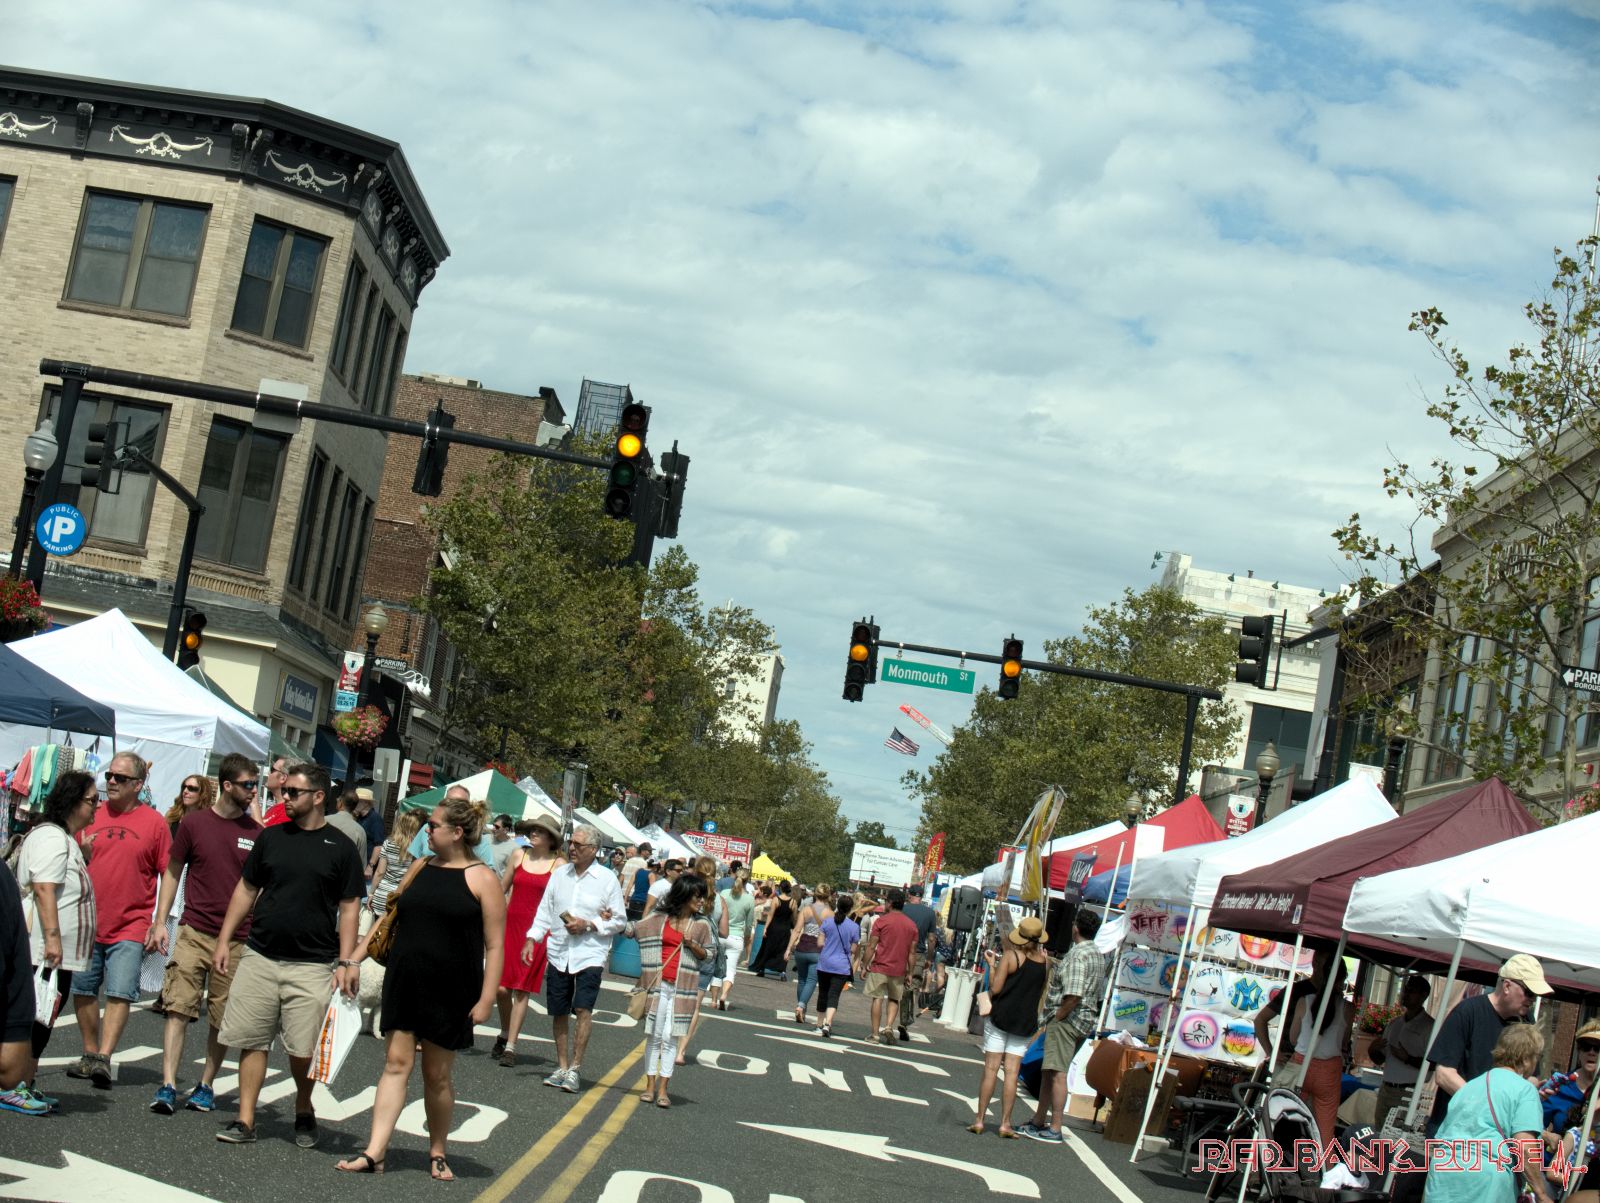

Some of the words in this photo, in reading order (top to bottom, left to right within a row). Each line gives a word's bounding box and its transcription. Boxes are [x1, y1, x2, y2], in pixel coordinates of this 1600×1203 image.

[49, 506, 79, 518] PUBLIC
[51, 515, 76, 543] P
[43, 540, 73, 552] PARKING
[380, 659, 407, 668] PARKING
[888, 664, 948, 685] Monmouth
[960, 672, 968, 681] St
[1575, 669, 1600, 686] PAR
[1130, 914, 1169, 931] JEFF
[1355, 1126, 1375, 1140] LBI
